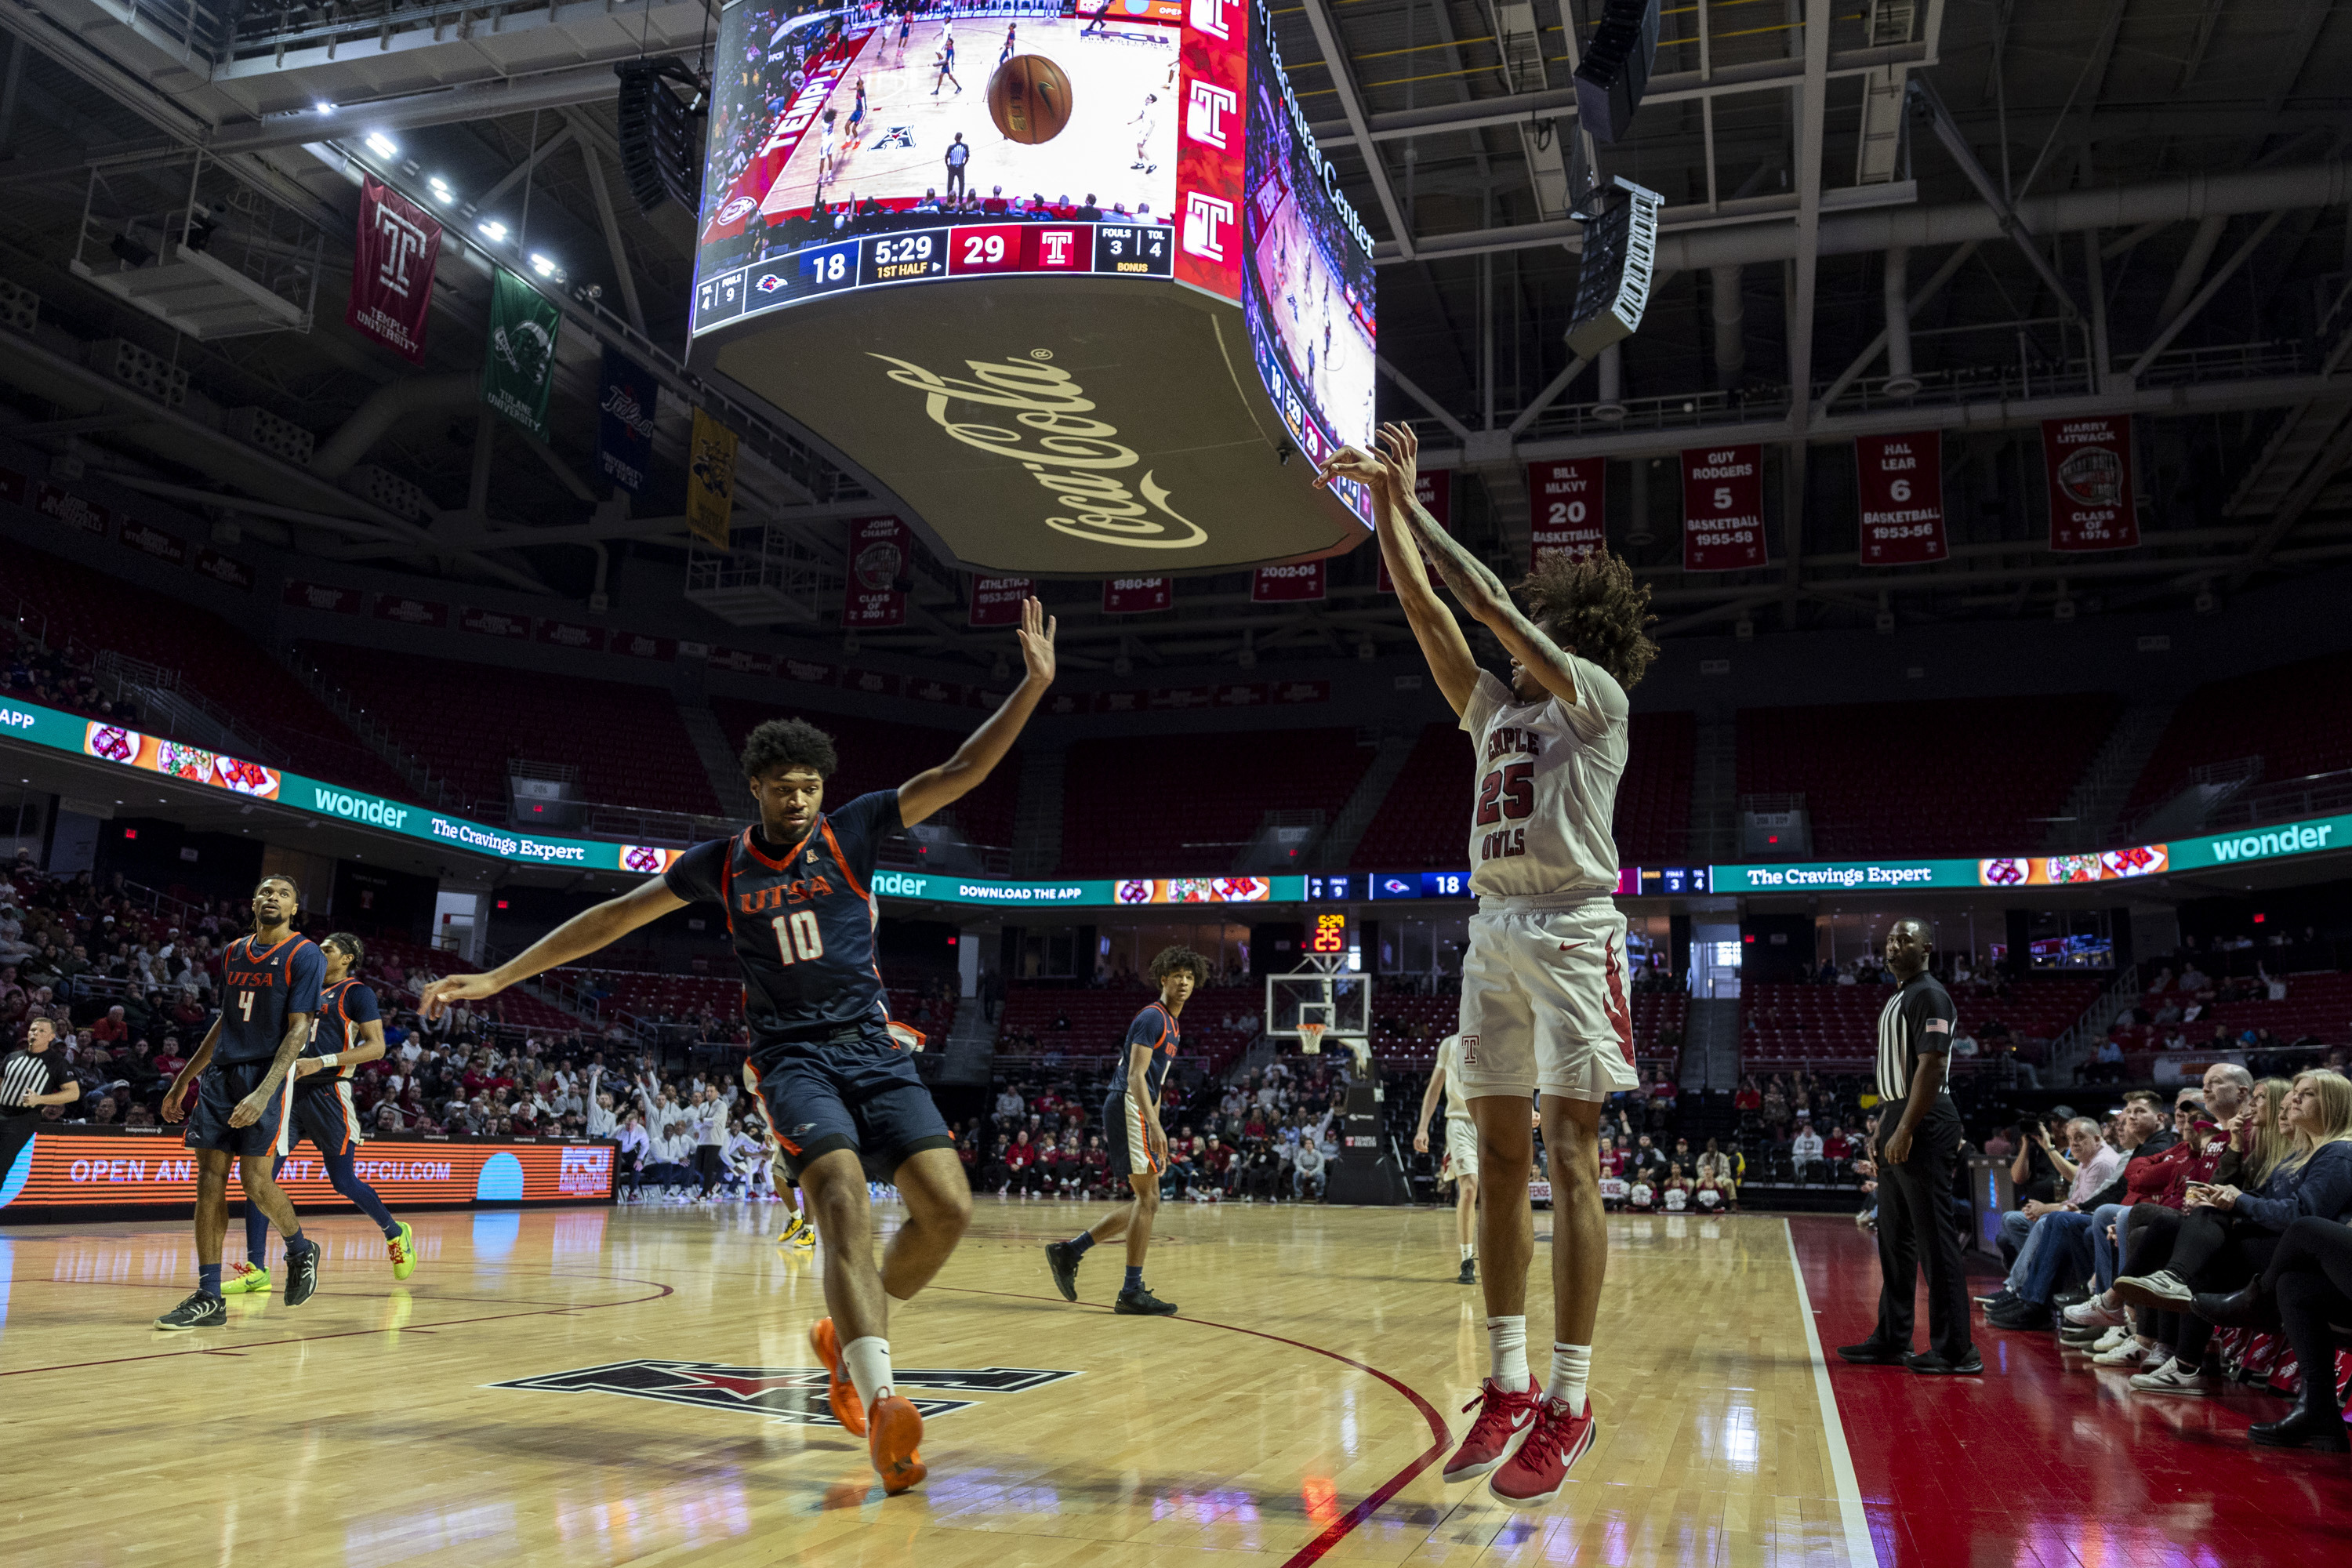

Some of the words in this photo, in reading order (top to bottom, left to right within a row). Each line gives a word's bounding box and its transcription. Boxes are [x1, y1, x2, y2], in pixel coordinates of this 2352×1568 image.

[1324, 161, 1375, 260] Center
[1102, 228, 1131, 239] FOULS
[1147, 230, 1165, 240] TOL
[875, 235, 932, 264] 5:29
[964, 235, 1005, 265] 29
[1110, 240, 1123, 254] 3
[1149, 241, 1161, 257] 4
[813, 252, 846, 284] 18
[877, 263, 897, 278] 1ST
[898, 261, 928, 276] HALF
[1116, 262, 1148, 273] BONUS
[721, 273, 742, 289] FOULS
[726, 287, 735, 302] 9
[702, 296, 710, 310] 4
[371, 306, 408, 337] TEMPLE
[357, 309, 419, 354] UNIVERSITY
[487, 392, 541, 431] UNIVERSITY
[601, 384, 654, 438] Tulsa
[2063, 421, 2108, 434] HARRY
[2056, 430, 2116, 444] LITWACK
[865, 352, 1208, 549] Coca-Cola
[1708, 451, 1735, 464] GUY
[1884, 443, 1912, 456] HAL
[1693, 463, 1753, 480] RODGERS
[1882, 457, 1916, 470] LEAR
[1553, 466, 1578, 479] BILL
[1544, 480, 1587, 495] MLKVY
[1890, 479, 1912, 502] 6
[1713, 487, 1733, 510] 5
[1548, 501, 1586, 524] 20
[1864, 507, 1940, 524] BASKETBALL
[2071, 510, 2115, 522] CLASS
[867, 519, 894, 529] JOHN
[1687, 515, 1759, 531] BASKETBALL
[1873, 523, 1933, 539] 1953-56
[2085, 521, 2102, 531] OF
[860, 527, 899, 538] CHANEY
[1533, 528, 1602, 543] BASKETBALL
[1697, 531, 1754, 546] 1955-58
[2079, 529, 2111, 540] 1976
[979, 578, 1029, 590] ATHLETICS
[858, 593, 891, 603] CLASS
[862, 610, 885, 619] 2001
[0, 708, 35, 729] APP
[1488, 728, 1539, 763] EMPLE
[1476, 762, 1534, 826] 25
[315, 787, 407, 829] wonder
[431, 817, 459, 840] The
[459, 825, 517, 855] Cravings
[519, 839, 585, 861] Expert
[1482, 828, 1525, 860] OWLS
[2212, 824, 2332, 862] wonder
[870, 874, 927, 895] nder
[1670, 878, 1679, 891] 3
[1694, 877, 1704, 890] 4
[1747, 868, 1784, 885] The
[1784, 867, 1864, 887] Cravings
[1867, 866, 1932, 885] Expert
[960, 884, 1032, 899] DOWNLOAD
[1033, 887, 1057, 900] THE
[1058, 887, 1082, 899] APP
[1312, 886, 1321, 898] 4
[1334, 886, 1342, 898] 9
[1436, 876, 1459, 894] 18
[739, 876, 833, 914] UTSA
[1318, 914, 1345, 929] 5:29
[771, 909, 824, 966] 10
[1314, 927, 1341, 951] 25
[227, 971, 273, 987] UTSA
[238, 991, 256, 1022] 4
[560, 1147, 610, 1173] PFCU
[70, 1159, 146, 1182] OPEN
[154, 1159, 192, 1182] AN
[354, 1161, 452, 1181] PFCU.COM
